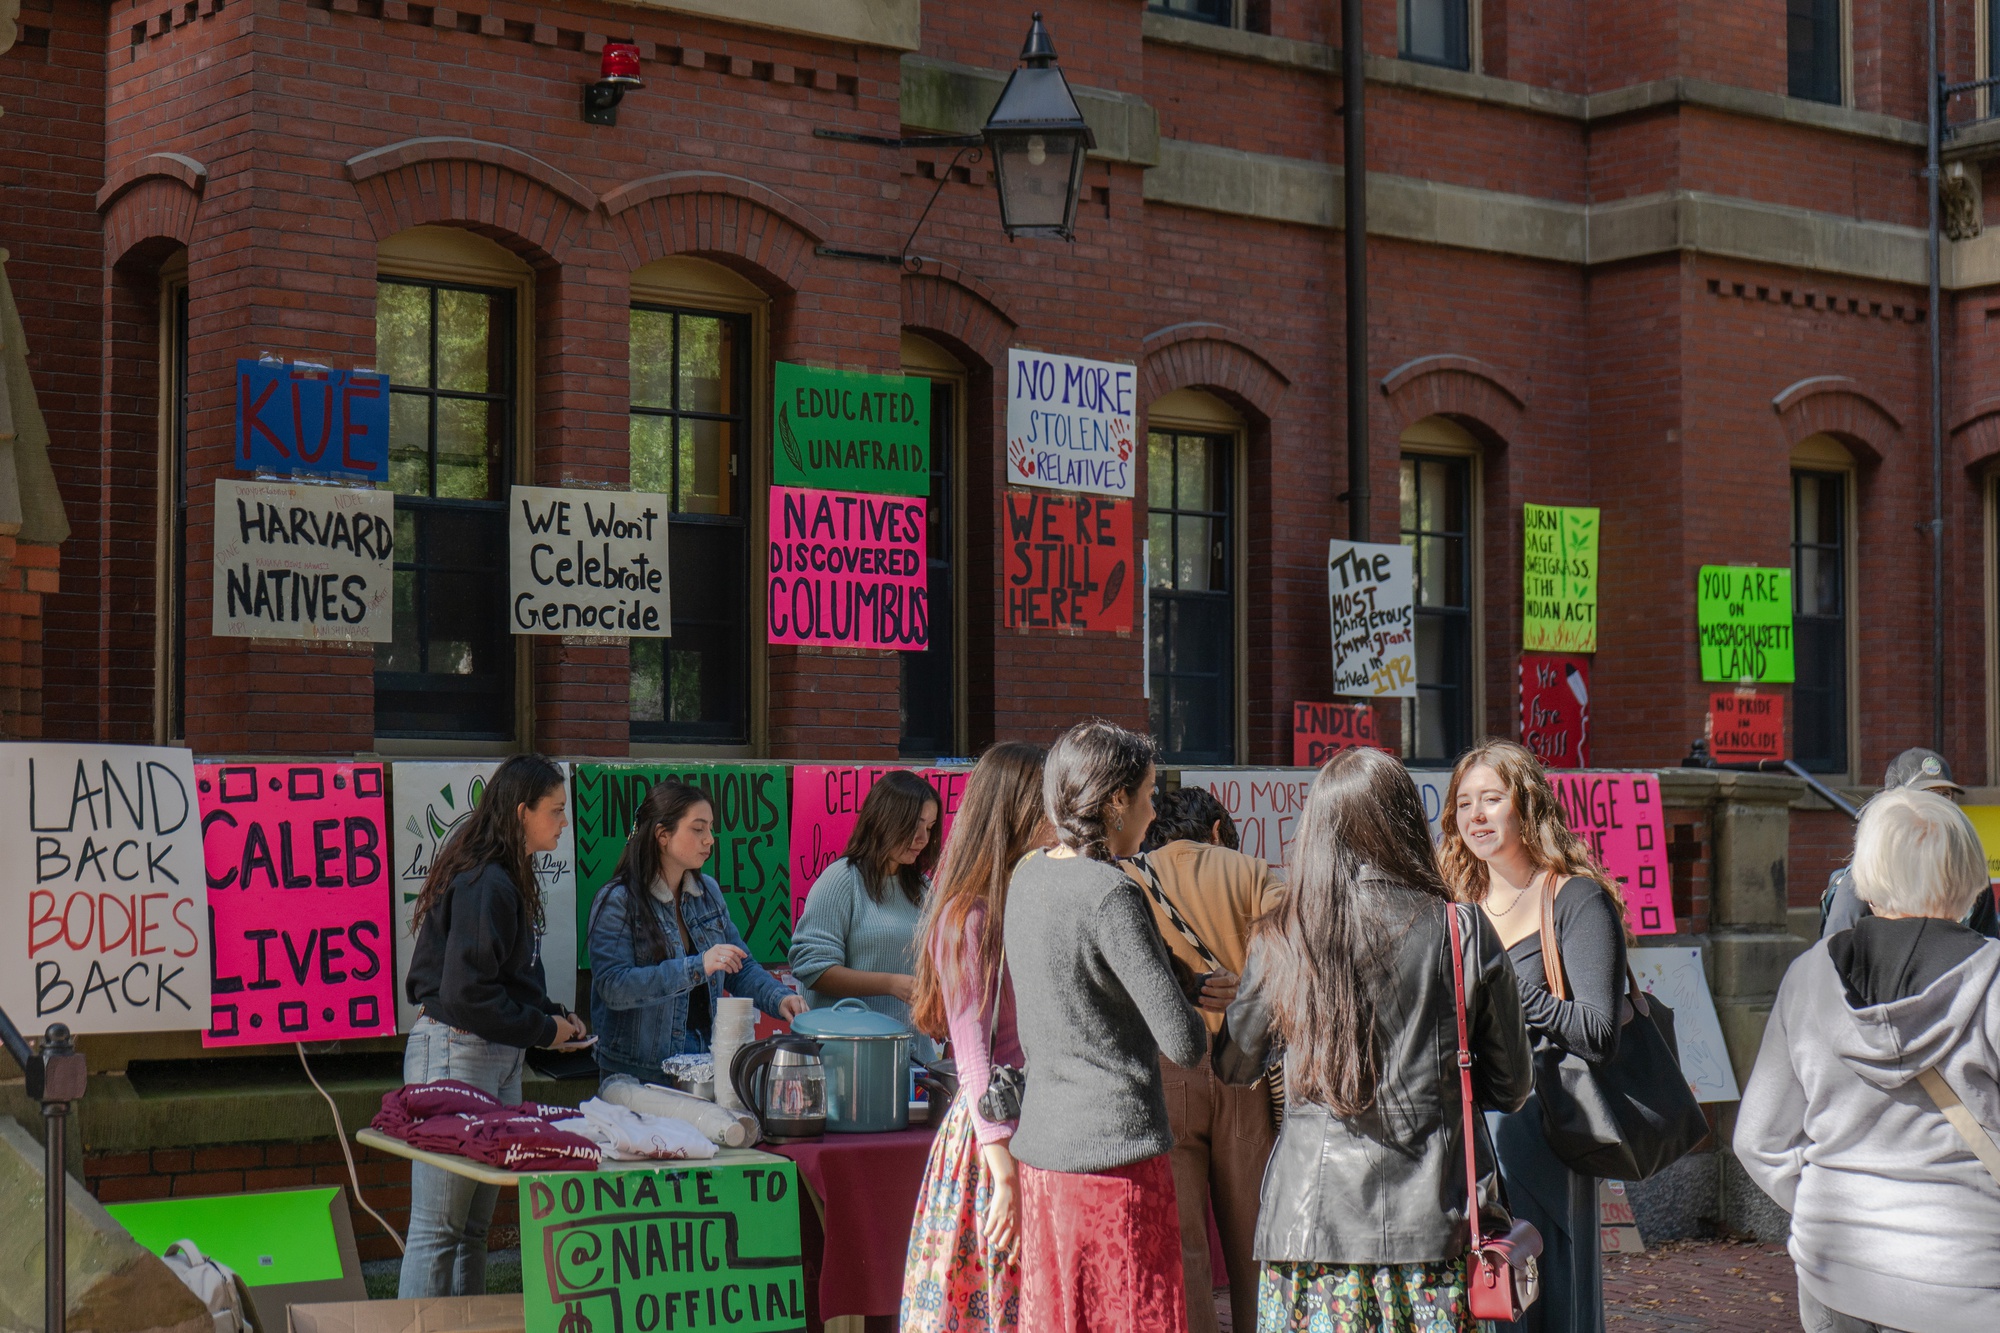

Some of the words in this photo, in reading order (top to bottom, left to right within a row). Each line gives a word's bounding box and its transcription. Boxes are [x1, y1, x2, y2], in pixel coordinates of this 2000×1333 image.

[796, 387, 920, 426] EDUCATED.
[1017, 360, 1055, 402] NO
[1061, 363, 1131, 416] MORE
[1027, 410, 1108, 452] STOLEN
[808, 439, 927, 473] UNAFRAID.
[1037, 451, 1127, 489] RELATIVES
[237, 498, 393, 560] HARVARD
[522, 499, 571, 535] WE
[584, 502, 658, 541] Won't
[784, 493, 924, 544] NATIVES
[1006, 494, 1116, 546] WE'RE
[1525, 508, 1557, 530] BURN
[530, 540, 662, 593] Celebrate
[771, 541, 920, 577] DISCOVERED
[1011, 542, 1098, 591] STILL
[1330, 546, 1391, 589] The
[227, 563, 367, 624] NATIVES
[1010, 587, 1087, 628] HERE
[1332, 586, 1377, 621] MOST
[1533, 578, 1554, 596] THE
[1703, 572, 1731, 601] YOU
[1741, 573, 1779, 602] ARE
[515, 592, 660, 631] Genocide
[770, 576, 928, 645] COLUMBUS
[1526, 600, 1560, 620] INDIAN
[1564, 603, 1594, 623] ACT
[1729, 602, 1744, 618] ON
[1701, 624, 1790, 649] MASSACHUSETT
[1370, 654, 1415, 695] 1492
[1536, 661, 1558, 688] We
[1719, 648, 1767, 680] LAND
[1529, 693, 1562, 728] Are
[1716, 697, 1733, 712] NO
[1738, 698, 1773, 714] PRIDE
[1714, 731, 1778, 749] GENOCIDE
[29, 758, 189, 836] LAND
[1210, 780, 1241, 813] NO
[1251, 780, 1309, 813] MORE
[36, 836, 180, 884] BACK
[202, 808, 381, 891] CALEB
[541, 853, 567, 884] Day
[28, 889, 198, 959] BODIES
[208, 905, 380, 994] LIVES
[35, 960, 192, 1018] BACK
[529, 1171, 719, 1220] DONATE
[743, 1170, 788, 1203] TO
[555, 1220, 720, 1290] @NAHC
[635, 1279, 805, 1333] OFFICIAL
